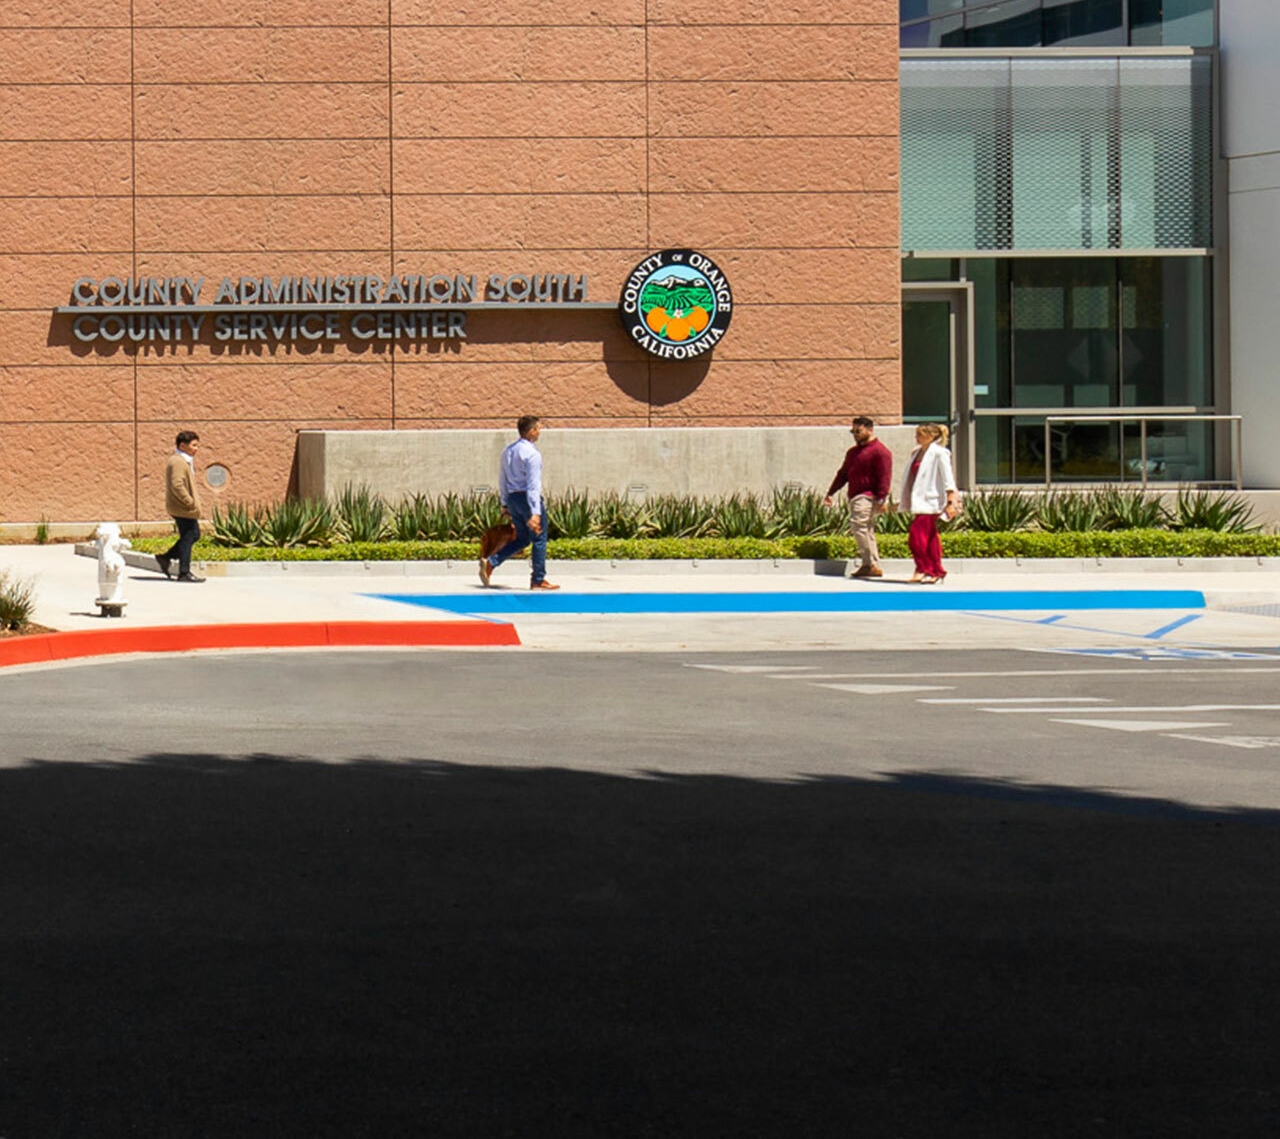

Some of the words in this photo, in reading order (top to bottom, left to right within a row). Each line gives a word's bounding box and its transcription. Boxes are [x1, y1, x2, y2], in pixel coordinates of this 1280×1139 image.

[73, 276, 206, 304] COUNTY
[213, 274, 478, 303] ADMINISTRATION
[488, 273, 588, 301] SOUTH
[623, 253, 663, 314] COUNTY
[688, 253, 731, 313] ORANGE
[73, 314, 206, 342] COUNTY
[214, 313, 341, 341] SERVICE
[351, 312, 467, 340] CENTER
[631, 325, 725, 359] CALIFORNIA
